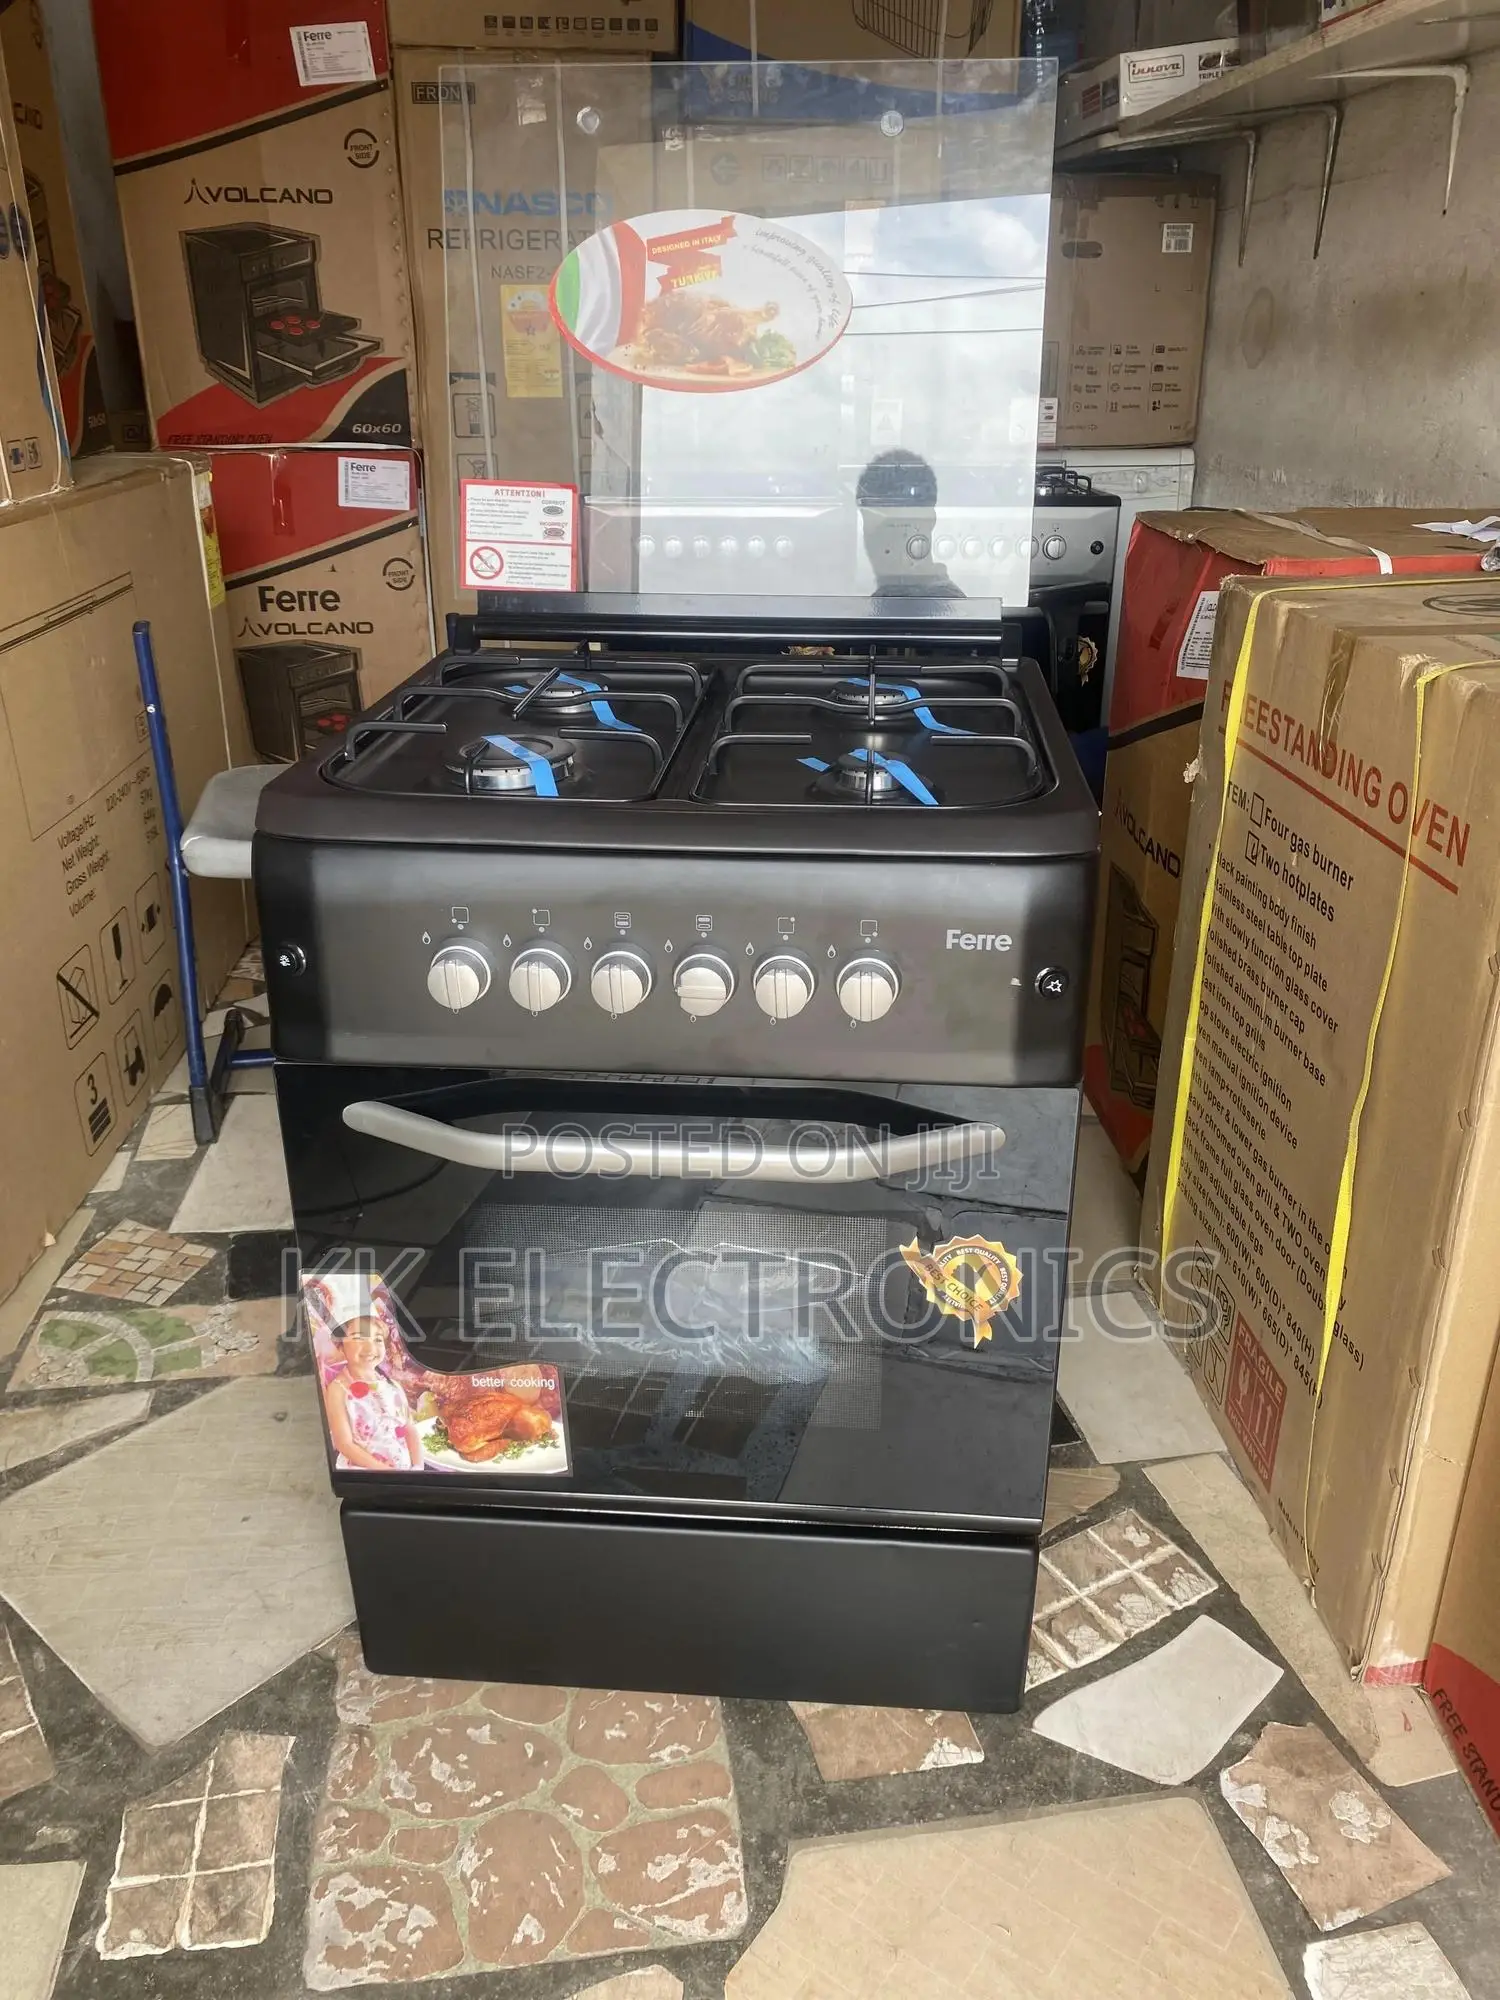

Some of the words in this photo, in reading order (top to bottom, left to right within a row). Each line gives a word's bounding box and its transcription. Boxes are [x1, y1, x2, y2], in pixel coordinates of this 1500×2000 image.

[303, 31, 332, 41] Ferre
[415, 86, 470, 100] FRON
[1132, 62, 1181, 76] innova
[204, 186, 333, 204] VOLCANO
[427, 228, 592, 250] REFRIGERAT
[651, 241, 690, 255] DESIGNED
[692, 238, 701, 246] IN
[701, 234, 722, 244] ITALY
[352, 422, 402, 434] 60x60
[350, 462, 376, 472] Ferre
[494, 488, 546, 498] ATTENTION!
[258, 586, 341, 612] Ferre
[258, 622, 374, 636] VOLCANO
[1220, 680, 1382, 808] FEESTANDING
[1122, 802, 1181, 879] VOLCANO
[1226, 780, 1250, 812] TEM:
[1264, 806, 1290, 840] Four
[1290, 830, 1311, 858] gas
[1312, 842, 1354, 892] burner
[61, 856, 76, 874] Net
[65, 870, 88, 896] Gross
[1260, 844, 1280, 876] Two
[1282, 862, 1335, 922] hotplates
[1218, 852, 1234, 876] lack
[1236, 870, 1268, 908] painting
[1268, 895, 1290, 928] body
[1291, 916, 1316, 950] finish
[946, 929, 1013, 952] Ferre
[1215, 878, 1245, 914] tainless
[1246, 908, 1266, 934] steel
[1267, 924, 1288, 954] table
[1288, 946, 1303, 970] top
[1304, 962, 1328, 992] plate
[1208, 926, 1237, 962] olished
[1238, 956, 1260, 987] brass
[1260, 976, 1289, 1016] burner
[1289, 1010, 1306, 1034] cap
[1225, 917, 1250, 950] slowly
[1251, 937, 1284, 982] function
[1285, 975, 1310, 1006] glass
[1310, 1000, 1338, 1034] cover
[1205, 948, 1234, 988] olished
[1234, 982, 1274, 1030] aluminum
[1274, 1020, 1302, 1060] burner
[1302, 1052, 1326, 1086] base
[1216, 986, 1231, 1012] iron
[1232, 1006, 1246, 1028] top
[1210, 1010, 1230, 1039] stove
[1230, 1033, 1260, 1074] electric
[1260, 1064, 1292, 1112] ignition
[1212, 1040, 1239, 1078] manual
[1239, 1068, 1269, 1116] ignition
[1270, 1109, 1298, 1150] device
[1188, 1091, 1205, 1119] eavy
[1204, 1113, 1236, 1160] chromed
[1236, 1154, 1257, 1186] oven
[1256, 1182, 1273, 1210] grill
[1273, 1204, 1280, 1220] &
[1282, 1210, 1302, 1249] TWO
[1303, 1246, 1326, 1282] oven
[1224, 1108, 1231, 1124] &
[1231, 1116, 1254, 1151] lower
[1252, 1148, 1268, 1173] gas
[1268, 1165, 1298, 1210] burner
[1298, 1202, 1307, 1226] in
[1308, 1218, 1323, 1244] the
[1193, 1148, 1209, 1176] high
[1209, 1172, 1246, 1230] adjustable
[1247, 1222, 1264, 1258] legs
[956, 1247, 974, 1256] BEST
[974, 1248, 1002, 1264] QUALITY
[1200, 1132, 1220, 1164] frame
[1220, 1158, 1234, 1183] full
[1234, 1180, 1254, 1212] glass
[1254, 1212, 1275, 1244] oven
[1276, 1236, 1296, 1270] door
[1296, 1264, 1326, 1316] (Doub
[1333, 1320, 1364, 1372] glass)
[925, 1264, 948, 1284] BEST
[947, 1282, 983, 1312] CHOICE
[1286, 1311, 1316, 1364] 840(H)
[472, 1375, 506, 1388] better
[510, 1376, 555, 1390] cooking
[1238, 1326, 1285, 1403] FRAGILE
[1432, 1688, 1468, 1741] FREE
